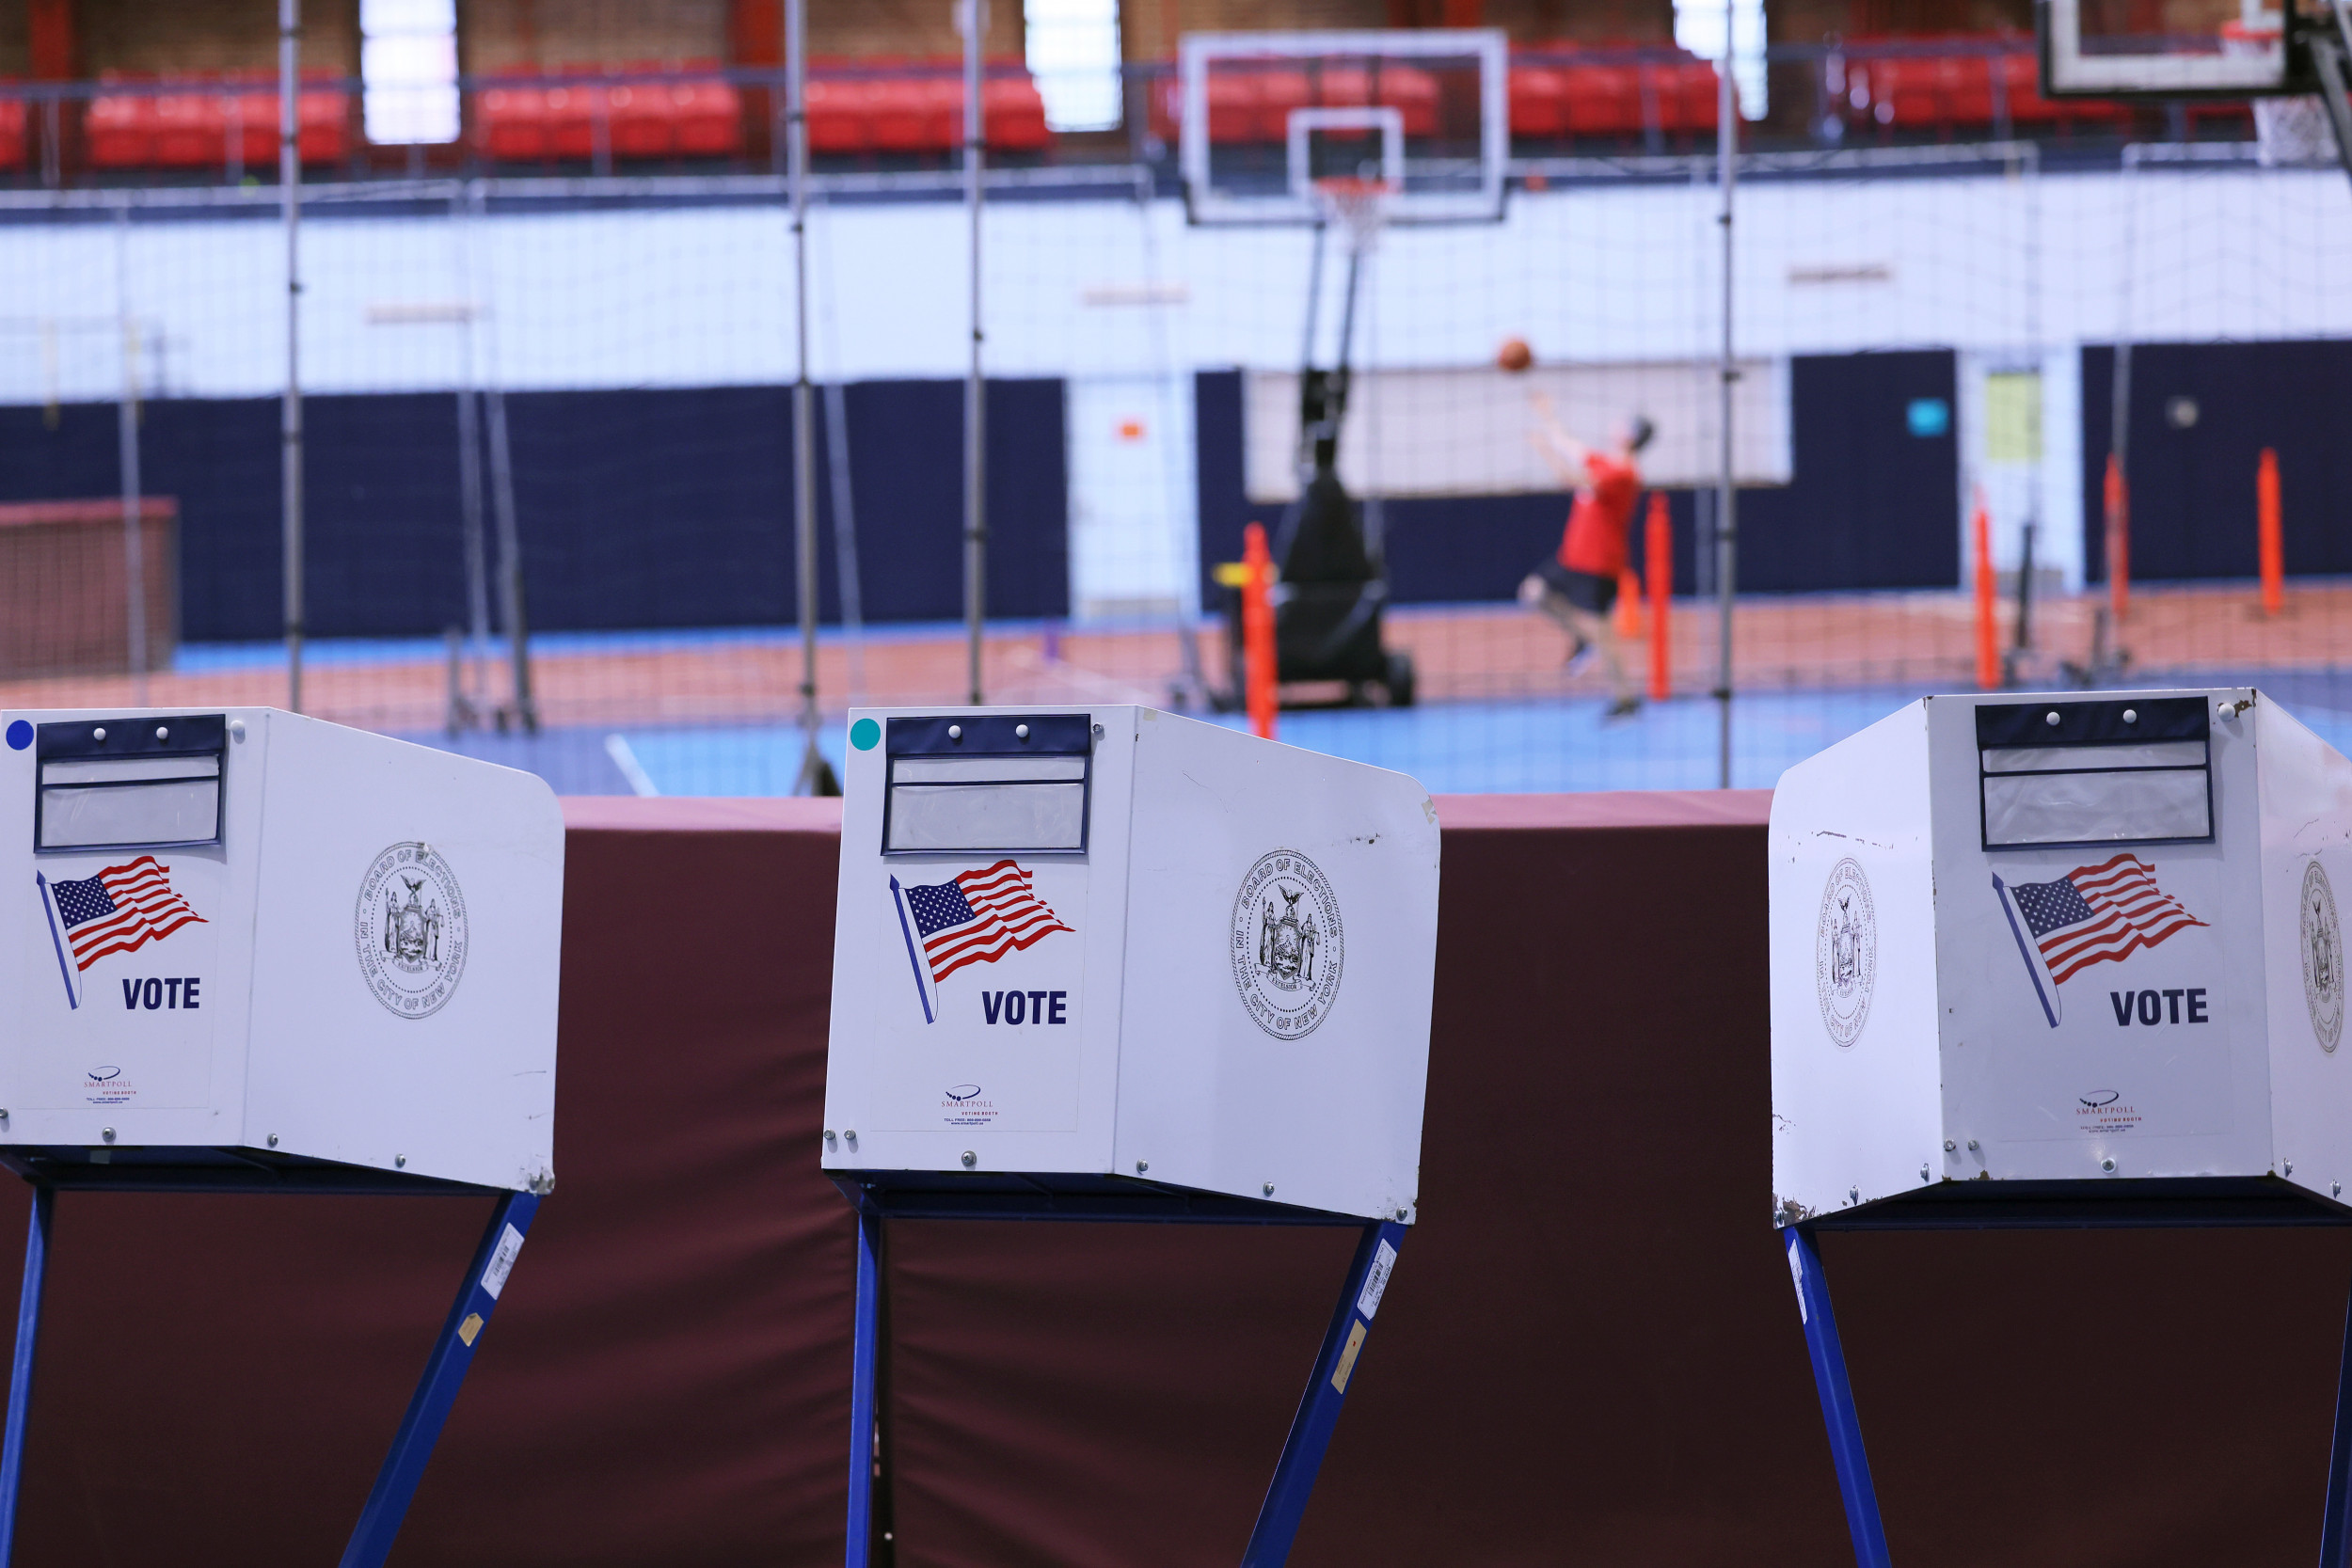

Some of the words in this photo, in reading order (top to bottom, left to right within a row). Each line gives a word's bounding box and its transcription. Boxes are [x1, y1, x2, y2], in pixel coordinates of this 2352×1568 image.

[364, 855, 395, 901] BOARD
[397, 849, 411, 863] OF
[415, 850, 461, 920] ELECTIONS
[1241, 863, 1274, 910] BOARD
[1276, 858, 1291, 872] OF
[1294, 861, 1338, 938] ELECTIONS
[360, 922, 368, 939] IN
[1235, 930, 1245, 949] IN
[362, 943, 378, 978] THE
[444, 941, 463, 983] YORK
[1237, 954, 1252, 991] THE
[121, 977, 200, 1010] VOTE
[376, 978, 403, 1006] CITY
[421, 982, 446, 1008] NEW
[1317, 960, 1338, 1006] YORK
[404, 997, 420, 1010] OF
[981, 990, 1067, 1025] VOTE
[1249, 993, 1275, 1024] CITY
[1294, 1004, 1318, 1030] NEW
[2109, 988, 2209, 1026] VOTE
[1276, 1016, 1292, 1030] OF
[2075, 1106, 2136, 1117] SMARTPOLL
